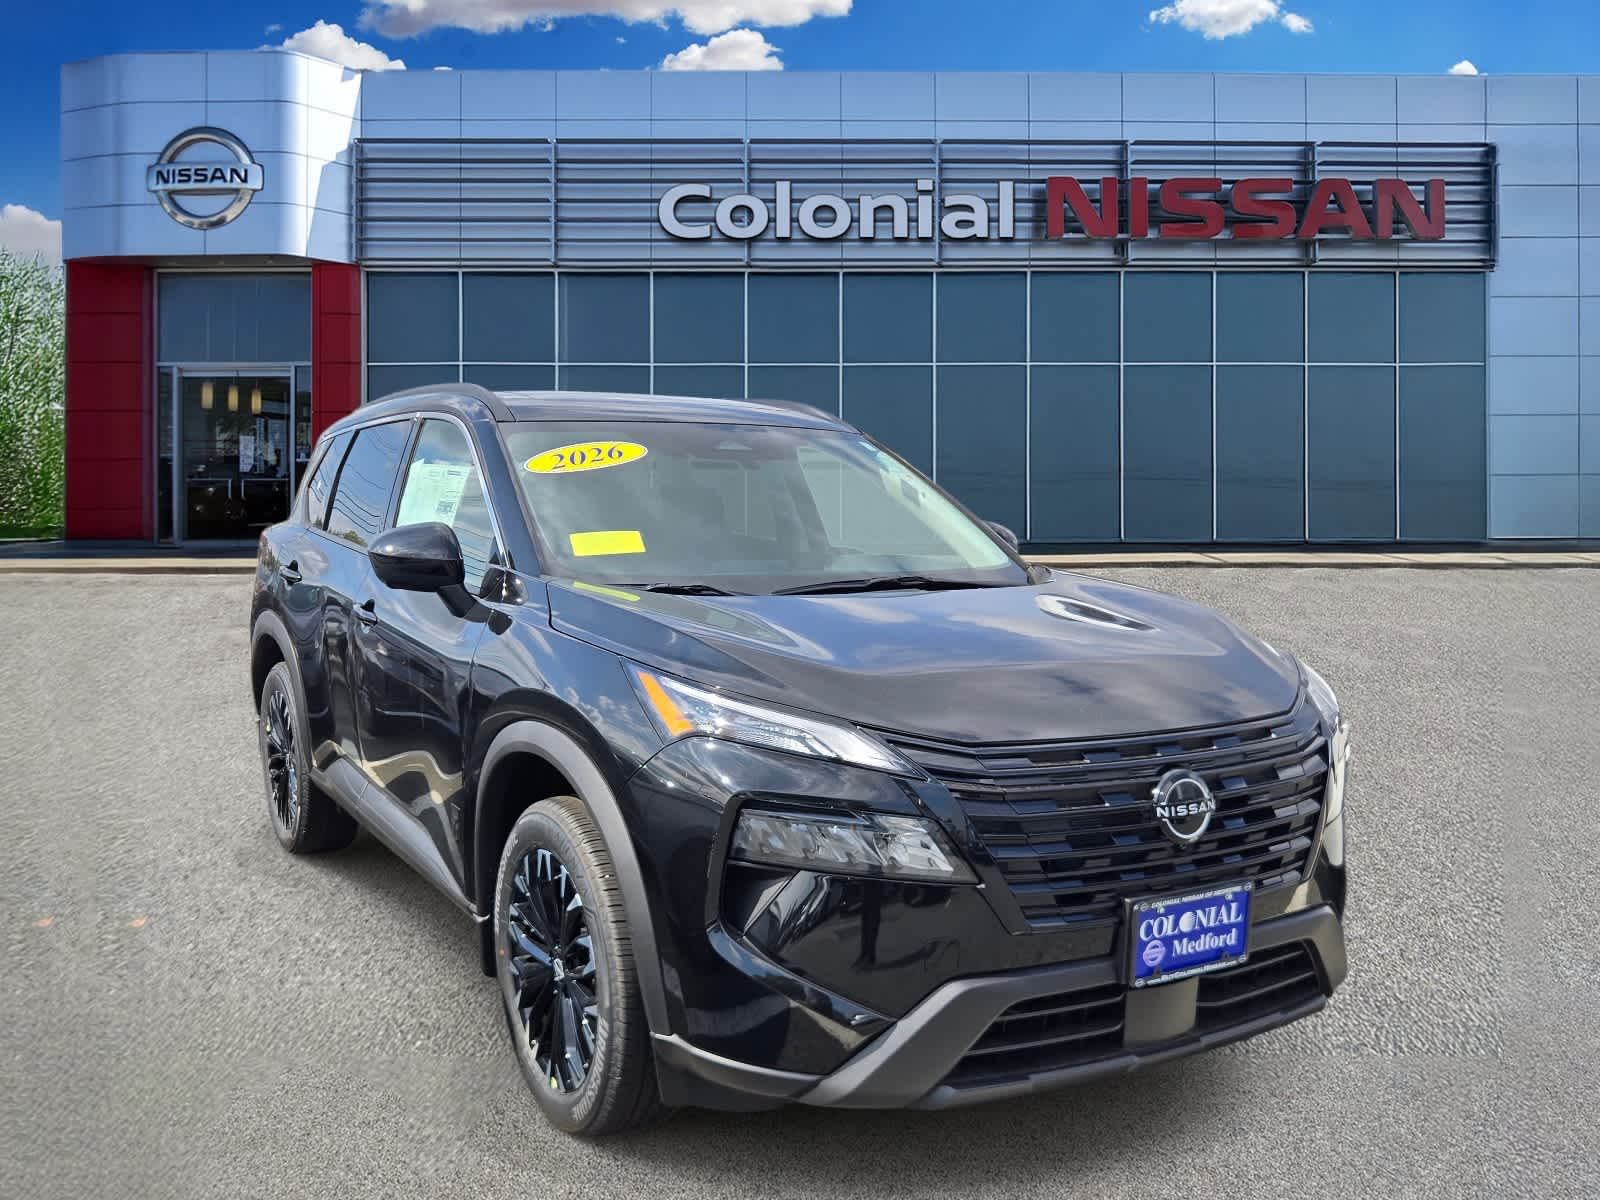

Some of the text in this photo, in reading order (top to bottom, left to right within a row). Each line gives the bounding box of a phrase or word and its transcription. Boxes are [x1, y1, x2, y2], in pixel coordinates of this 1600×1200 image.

[155, 167, 249, 185] NISSAN
[658, 175, 1446, 240] Colonial NISSAN
[551, 445, 623, 470] 2026
[1156, 800, 1216, 818] NISSAN
[1140, 902, 1242, 942] COLONIAL
[1172, 928, 1238, 958] Medford
